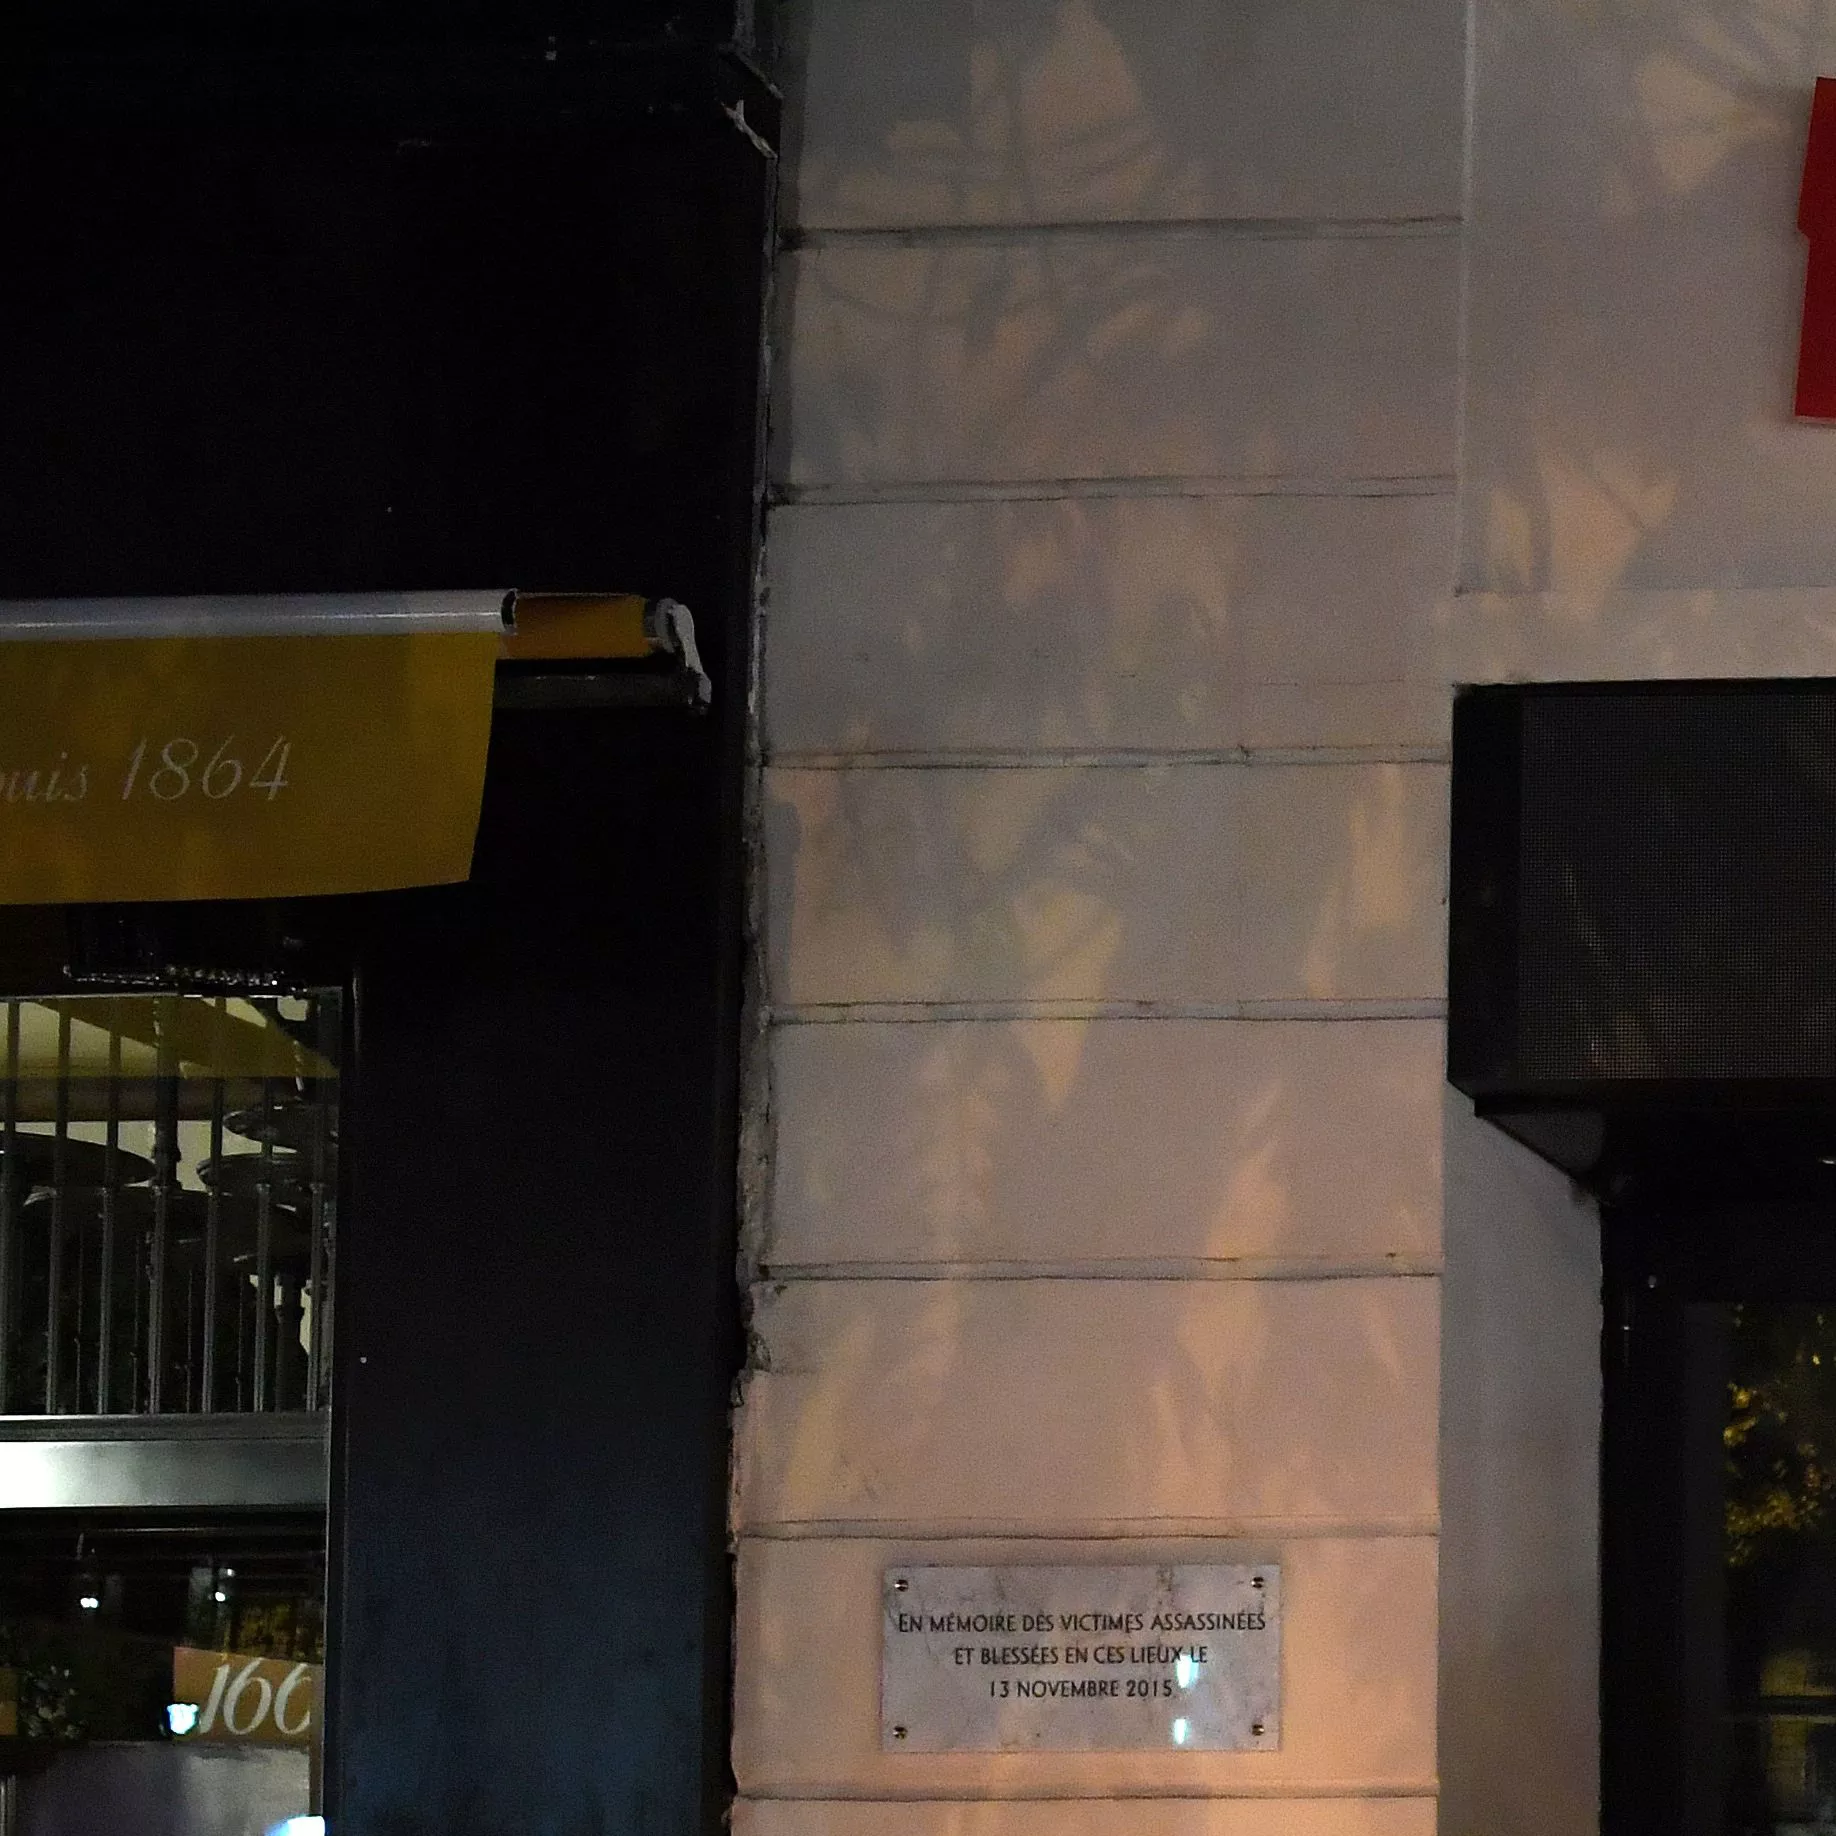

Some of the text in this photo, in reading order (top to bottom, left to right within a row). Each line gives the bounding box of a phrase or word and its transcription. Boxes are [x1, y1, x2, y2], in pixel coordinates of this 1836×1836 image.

[120, 733, 292, 802] 1864
[900, 1615, 923, 1633] EN
[1022, 1614, 1054, 1632] DES
[1061, 1613, 1144, 1632] VICTIMES
[954, 1647, 974, 1665] ET
[1065, 1646, 1088, 1664] EN
[1093, 1646, 1125, 1664] CES
[1131, 1646, 1182, 1664] LIEUX
[1190, 1645, 1209, 1664] LE
[989, 1679, 1173, 1698] 13 NOVEMBRE 2015
